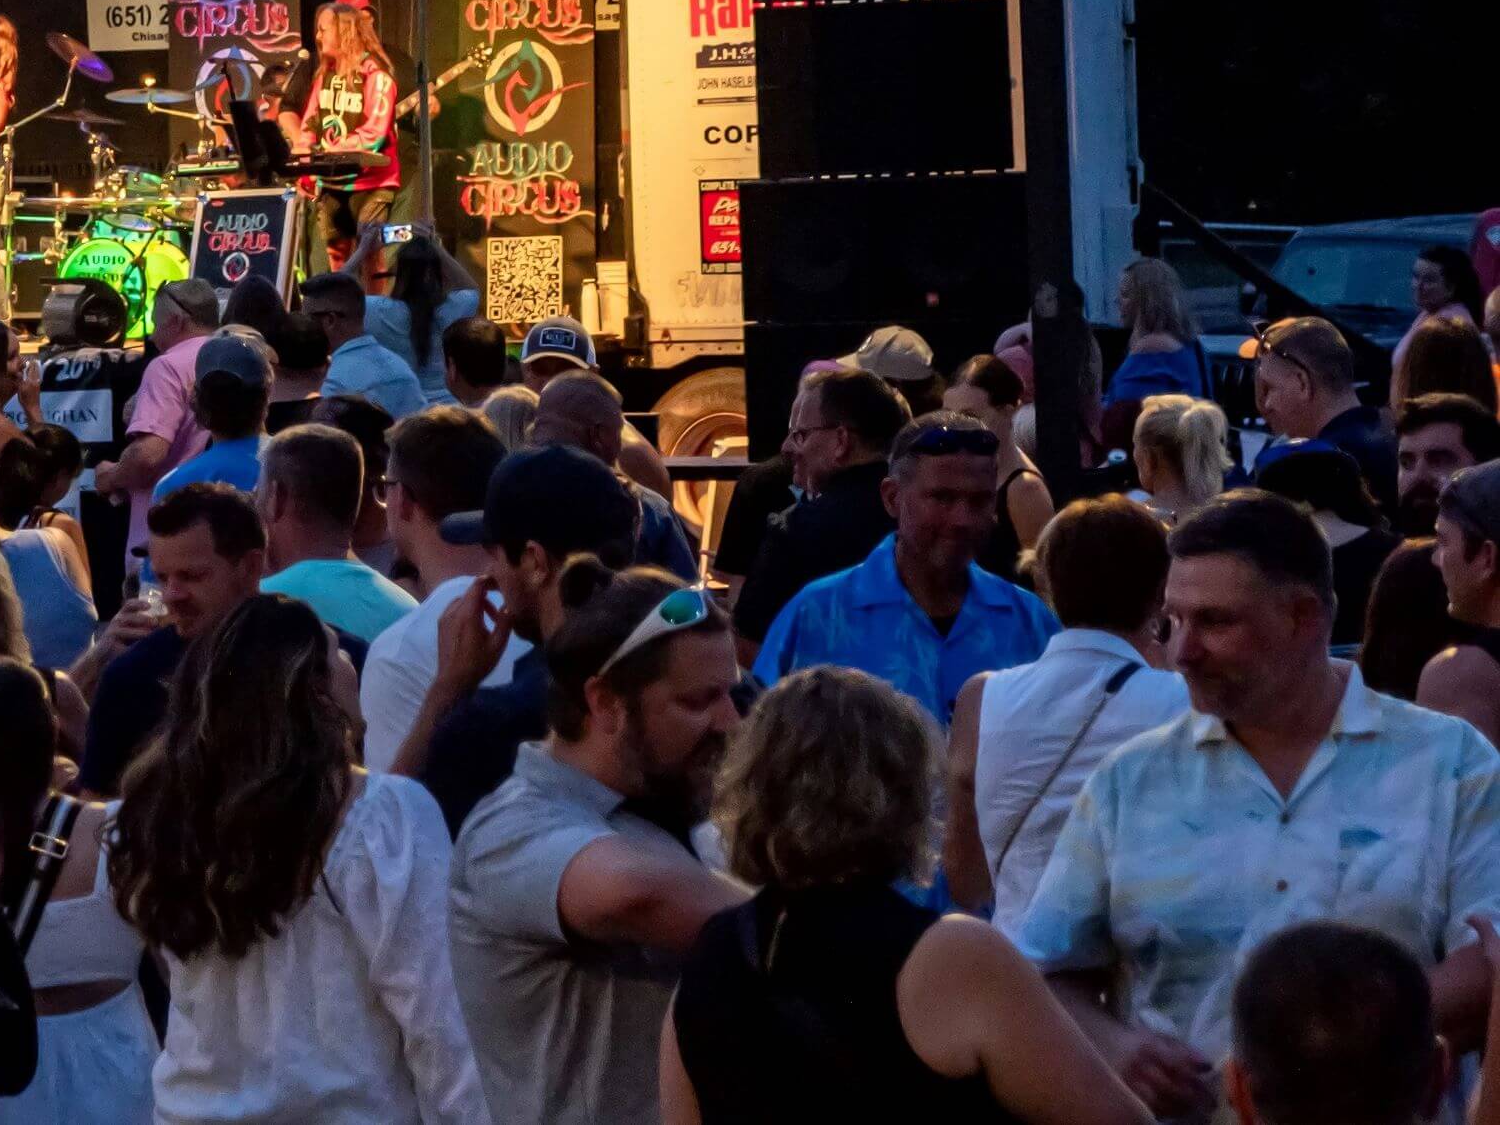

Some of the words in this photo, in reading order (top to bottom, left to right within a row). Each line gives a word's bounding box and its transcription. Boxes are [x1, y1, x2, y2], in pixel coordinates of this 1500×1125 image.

[106, 5, 151, 28] (651)
[175, 2, 290, 37] CIRCUS
[469, 141, 574, 176] AUDIO
[460, 180, 581, 217] CIRCUS
[215, 212, 269, 232] AUDIO
[79, 255, 126, 266] AUDIO
